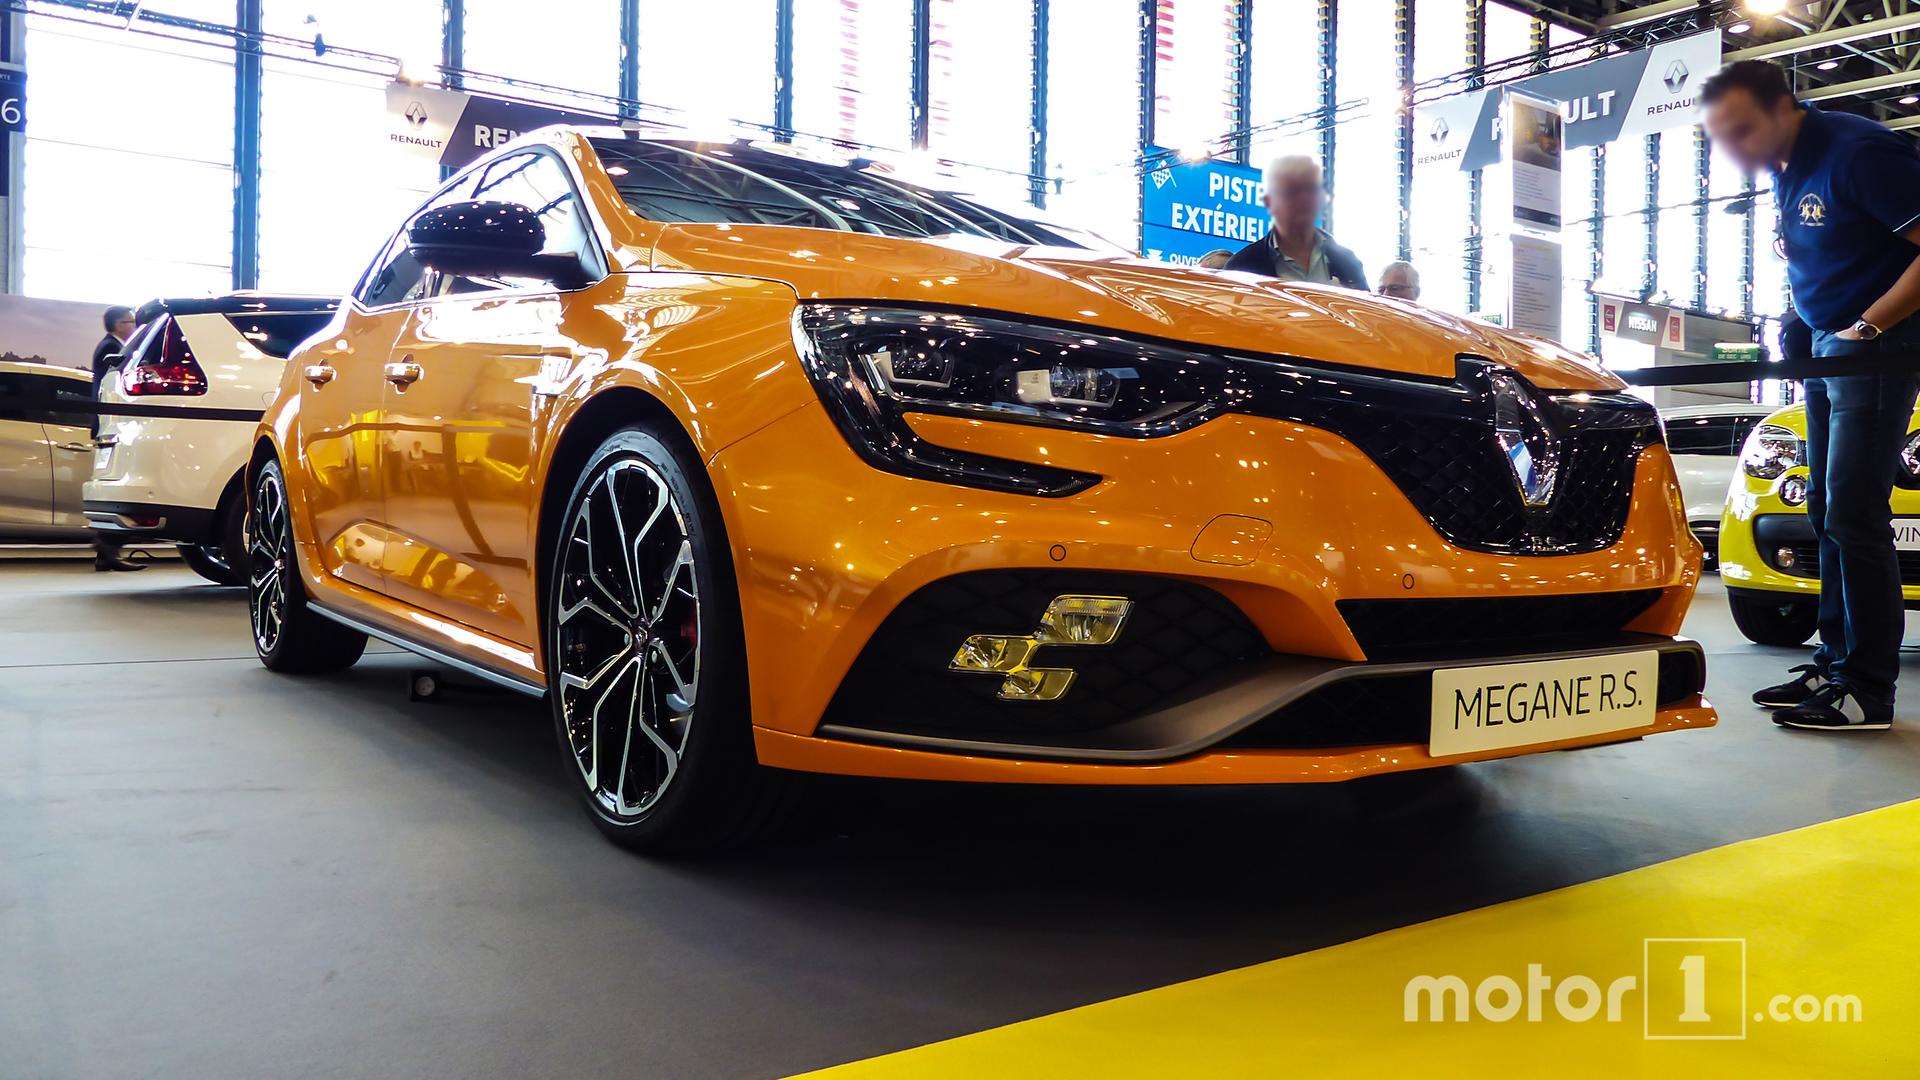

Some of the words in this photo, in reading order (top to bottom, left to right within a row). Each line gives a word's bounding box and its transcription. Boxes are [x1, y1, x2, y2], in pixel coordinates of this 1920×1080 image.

[1, 98, 21, 124] 6
[1647, 97, 1697, 116] RENAUL
[390, 133, 443, 149] RENAULT
[1417, 149, 1462, 165] RENAULT
[1628, 315, 1658, 332] NISSAN
[1454, 675, 1592, 730] MEGANE
[1600, 670, 1643, 712] R.S.
